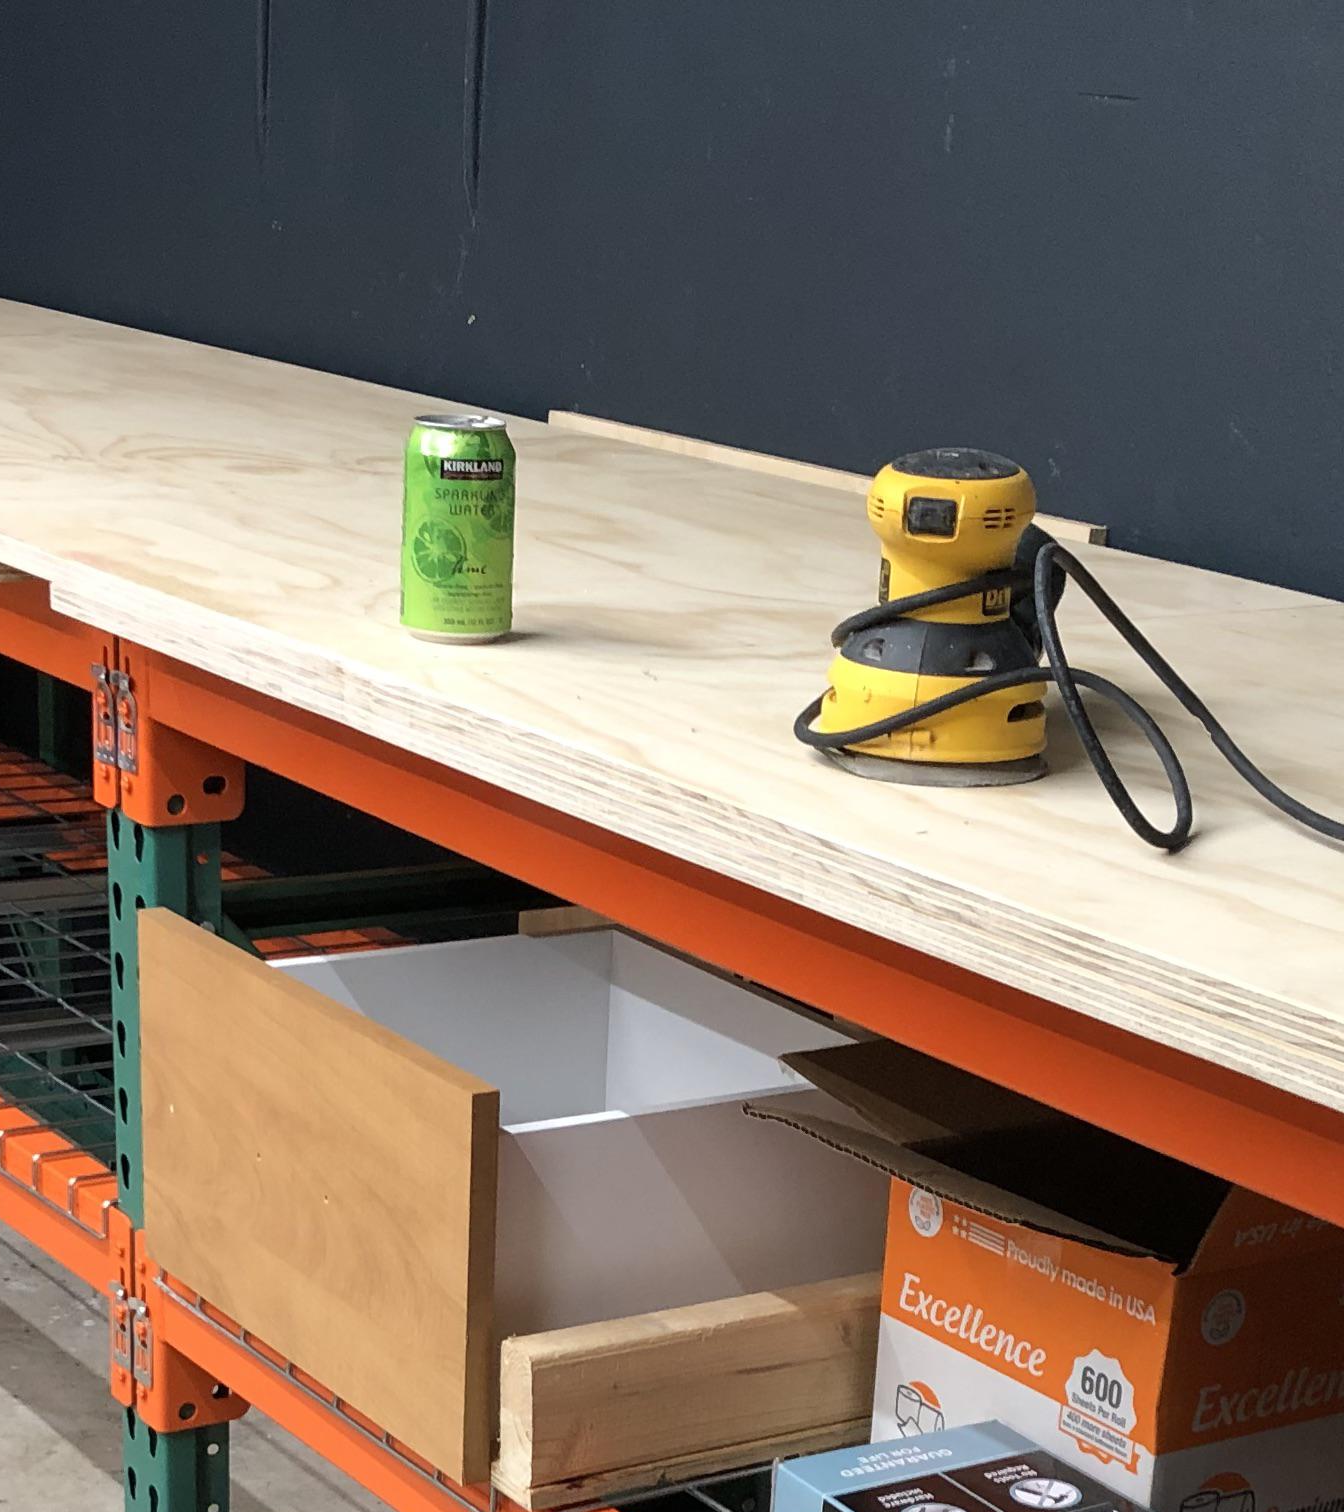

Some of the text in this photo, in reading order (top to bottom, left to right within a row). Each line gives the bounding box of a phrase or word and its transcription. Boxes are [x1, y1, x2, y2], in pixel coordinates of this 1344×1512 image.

[443, 460, 503, 473] KIRKLAND
[449, 504, 495, 516] WATER
[1006, 1240, 1156, 1327] Proudly made in USA
[899, 1272, 1047, 1377] Excellence
[1081, 1366, 1122, 1409] 600
[1071, 1392, 1127, 1429] Sheets Per Roll
[1081, 1418, 1101, 1435] more
[1101, 1430, 1127, 1449] sheets
[840, 1449, 953, 1477] GUARANTEED
[857, 1446, 921, 1465] FOR LIFE
[983, 1463, 1030, 1480] Required
[882, 1492, 934, 1509] Hardware
